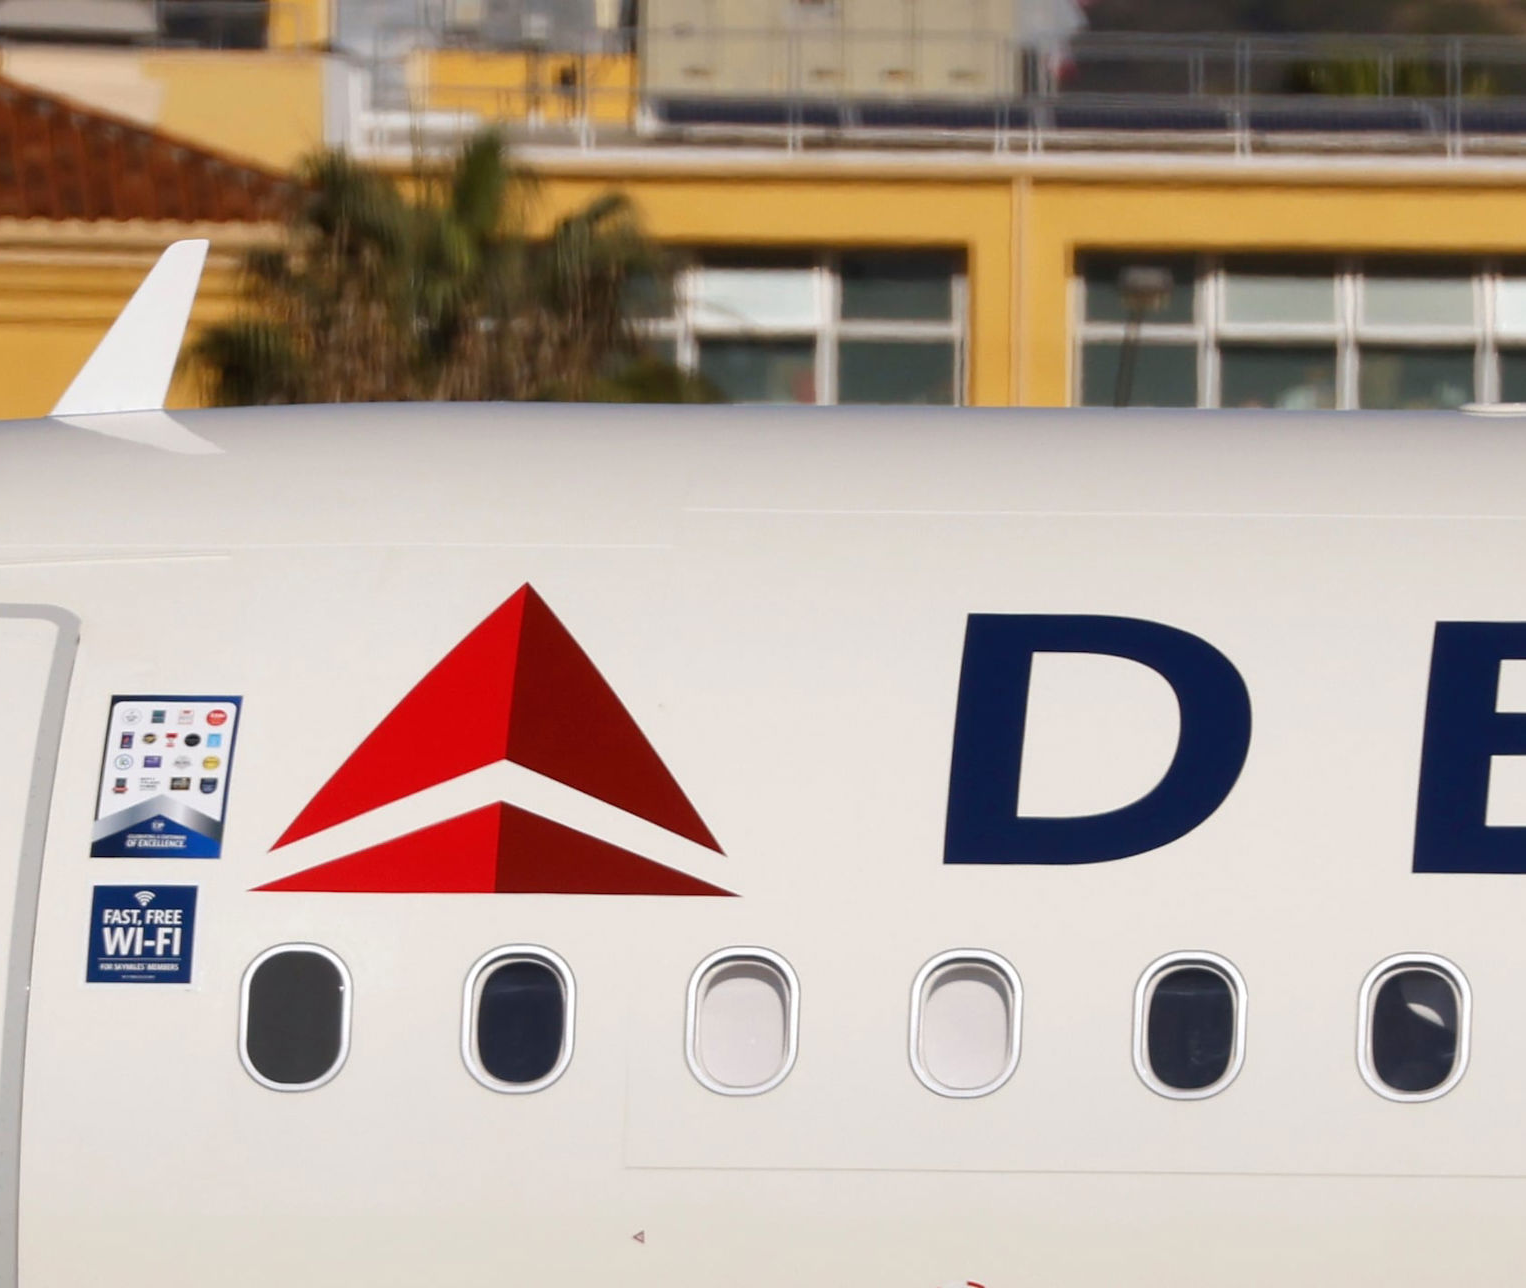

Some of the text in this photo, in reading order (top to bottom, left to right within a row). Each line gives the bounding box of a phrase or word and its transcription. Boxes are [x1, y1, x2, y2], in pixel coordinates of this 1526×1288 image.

[103, 909, 183, 926] FAST, FREE
[102, 926, 182, 956] WI-FI
